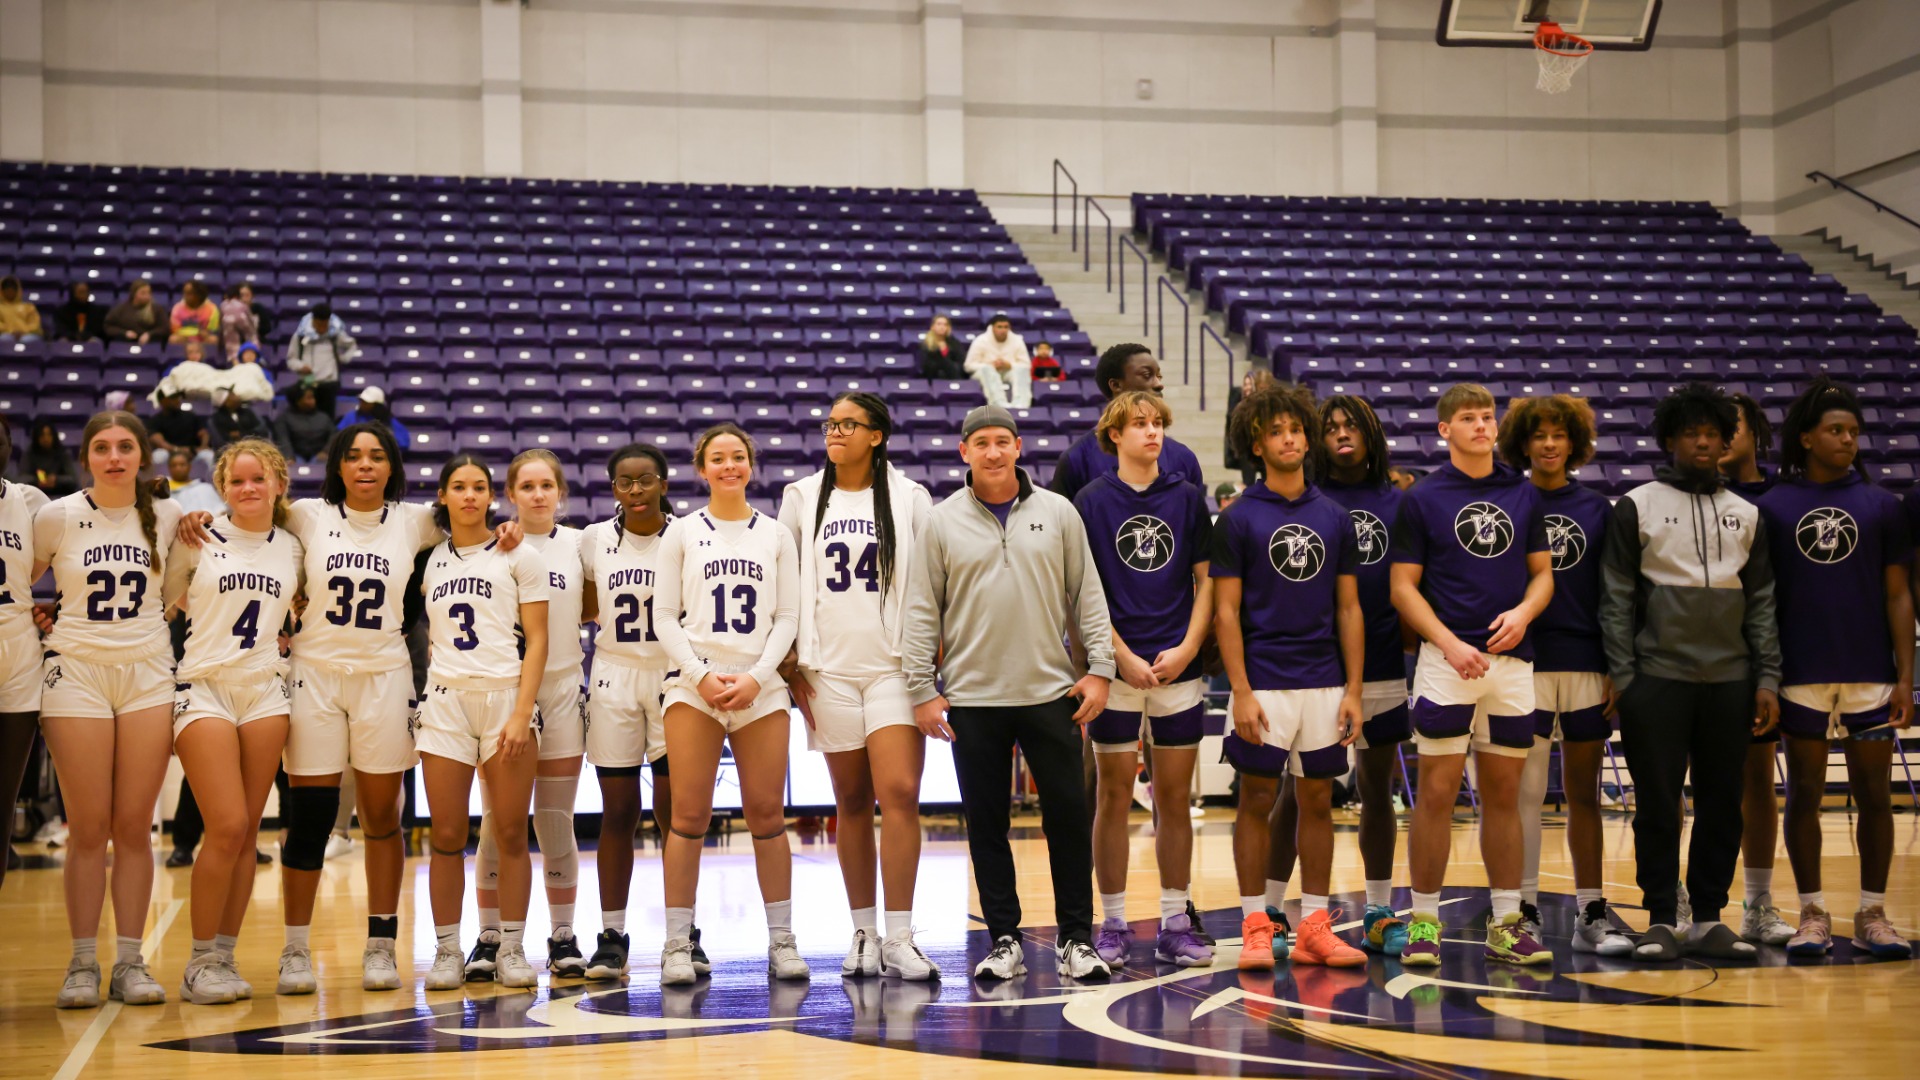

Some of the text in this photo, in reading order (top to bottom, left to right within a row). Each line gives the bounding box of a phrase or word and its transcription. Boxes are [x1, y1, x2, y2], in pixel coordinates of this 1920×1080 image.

[83, 544, 151, 567] COYOTES
[326, 553, 390, 577] COYOTES
[608, 568, 656, 590] COYOT
[704, 558, 763, 582] COYOTES
[825, 542, 879, 592] 34
[87, 570, 147, 621] 23
[219, 572, 281, 599] COYOTES
[325, 575, 386, 630] 32
[432, 577, 492, 602] COYOTES
[711, 583, 757, 634] 13
[232, 599, 261, 650] 4
[448, 602, 480, 651] 3
[614, 593, 659, 643] 21
